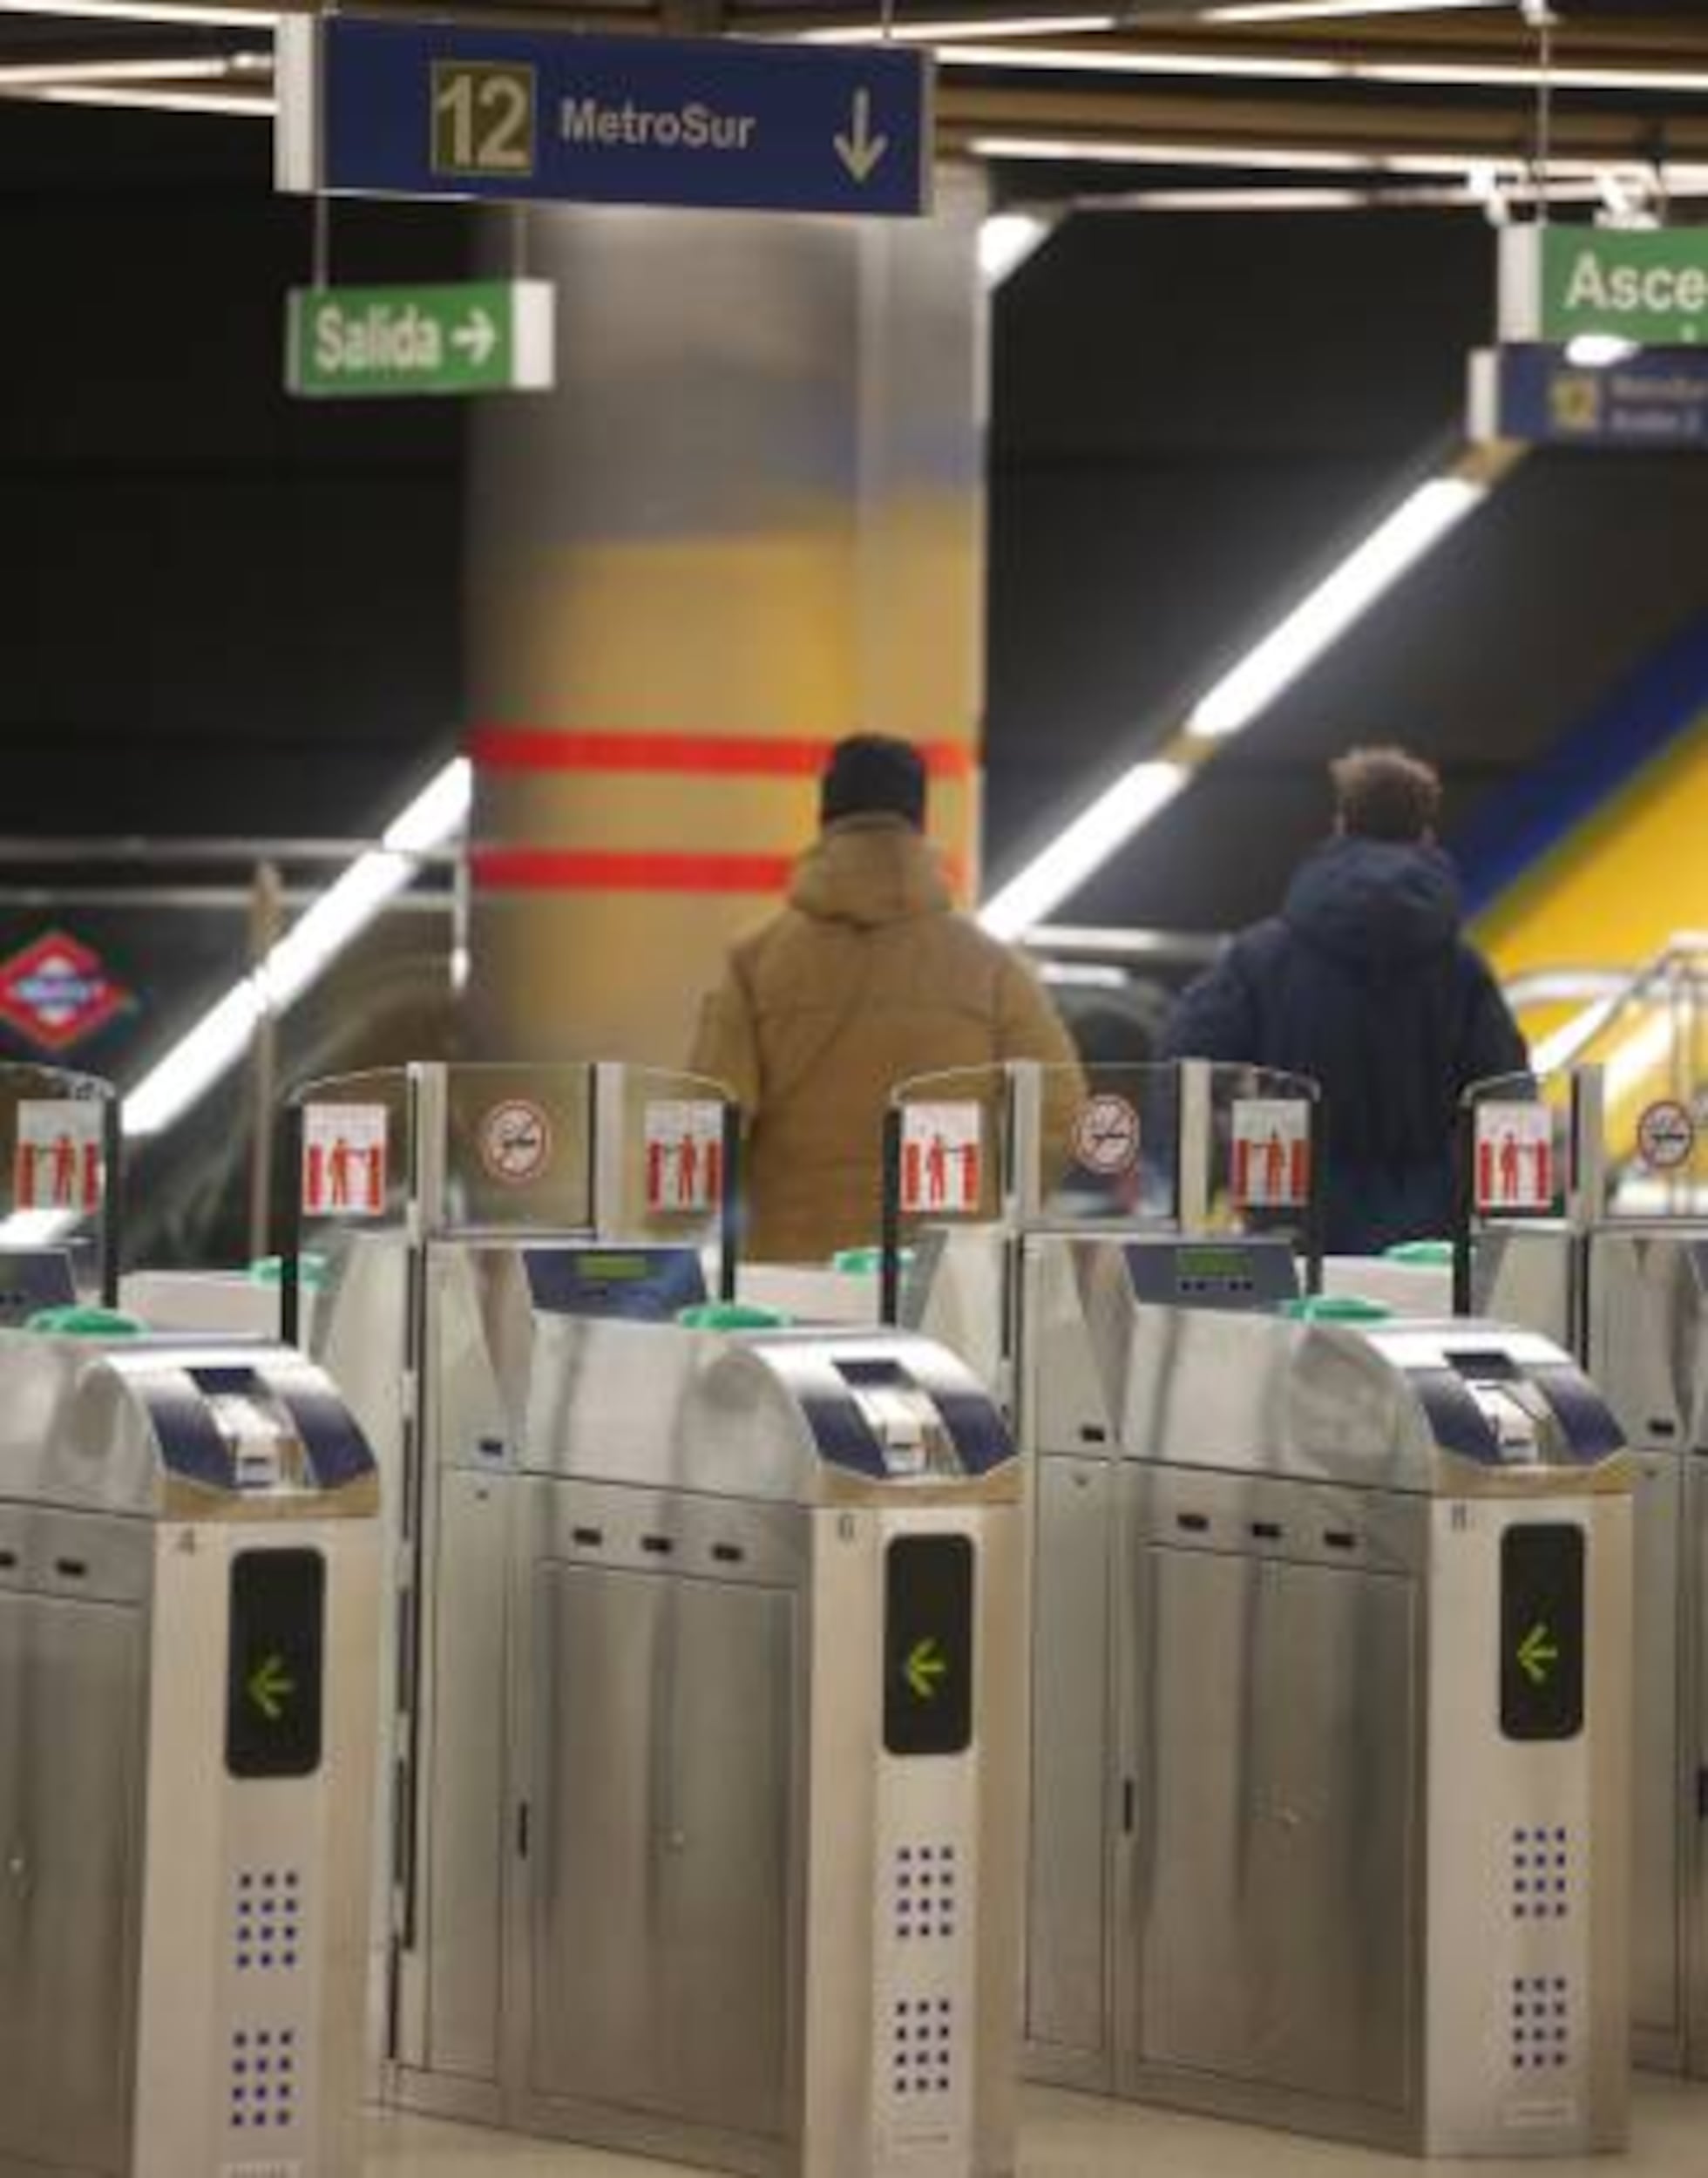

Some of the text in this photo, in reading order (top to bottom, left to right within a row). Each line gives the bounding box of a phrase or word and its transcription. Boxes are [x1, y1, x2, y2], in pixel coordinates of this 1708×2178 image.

[437, 74, 756, 166] 12 MetroSur
[315, 303, 442, 371] Salida
